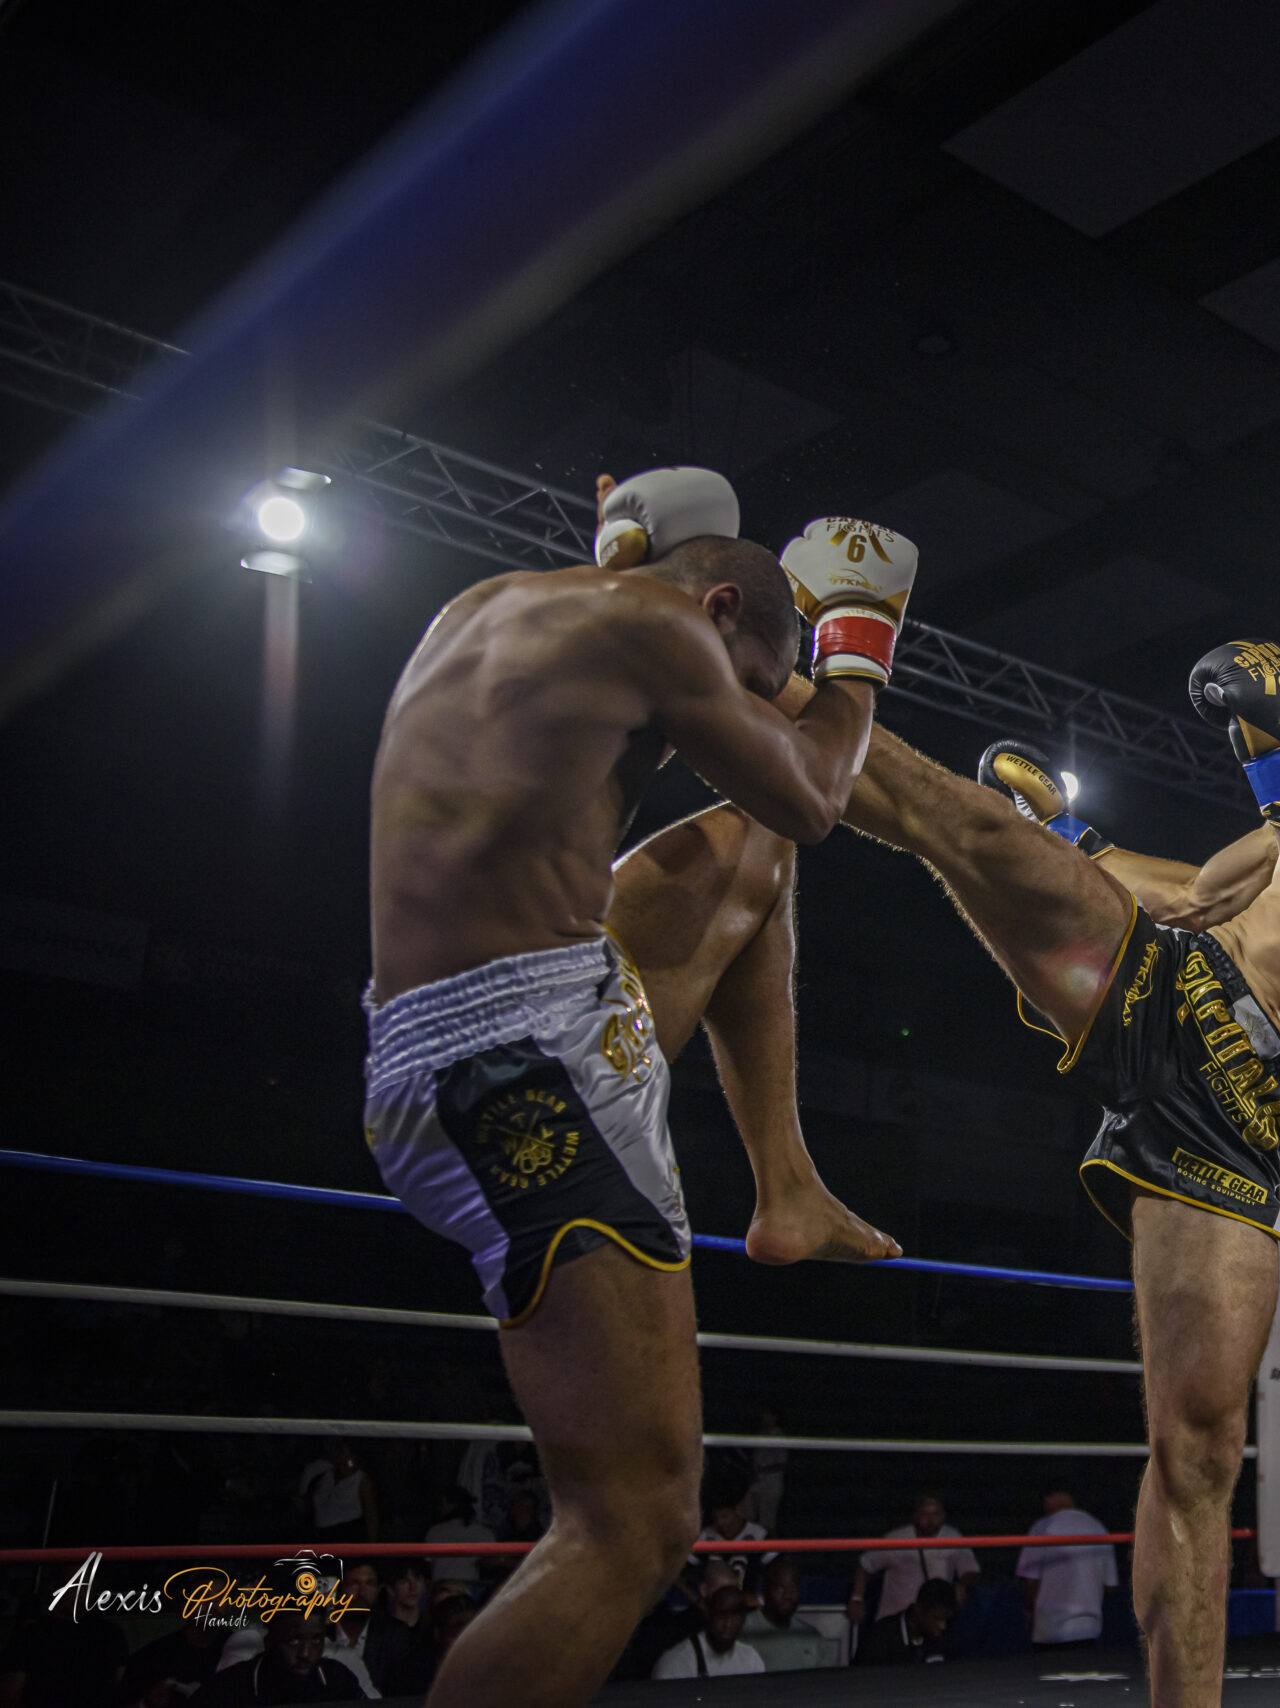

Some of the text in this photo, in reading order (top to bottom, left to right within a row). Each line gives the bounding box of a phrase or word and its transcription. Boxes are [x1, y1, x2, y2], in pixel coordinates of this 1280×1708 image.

[847, 533, 867, 564] 6
[1006, 755, 1057, 796] WETTLE GEAR
[1200, 1060, 1250, 1125] FIGHTS
[1177, 1151, 1265, 1202] WETTLE GEAR
[1177, 1166, 1256, 1206] BOXING EQUIPMENT
